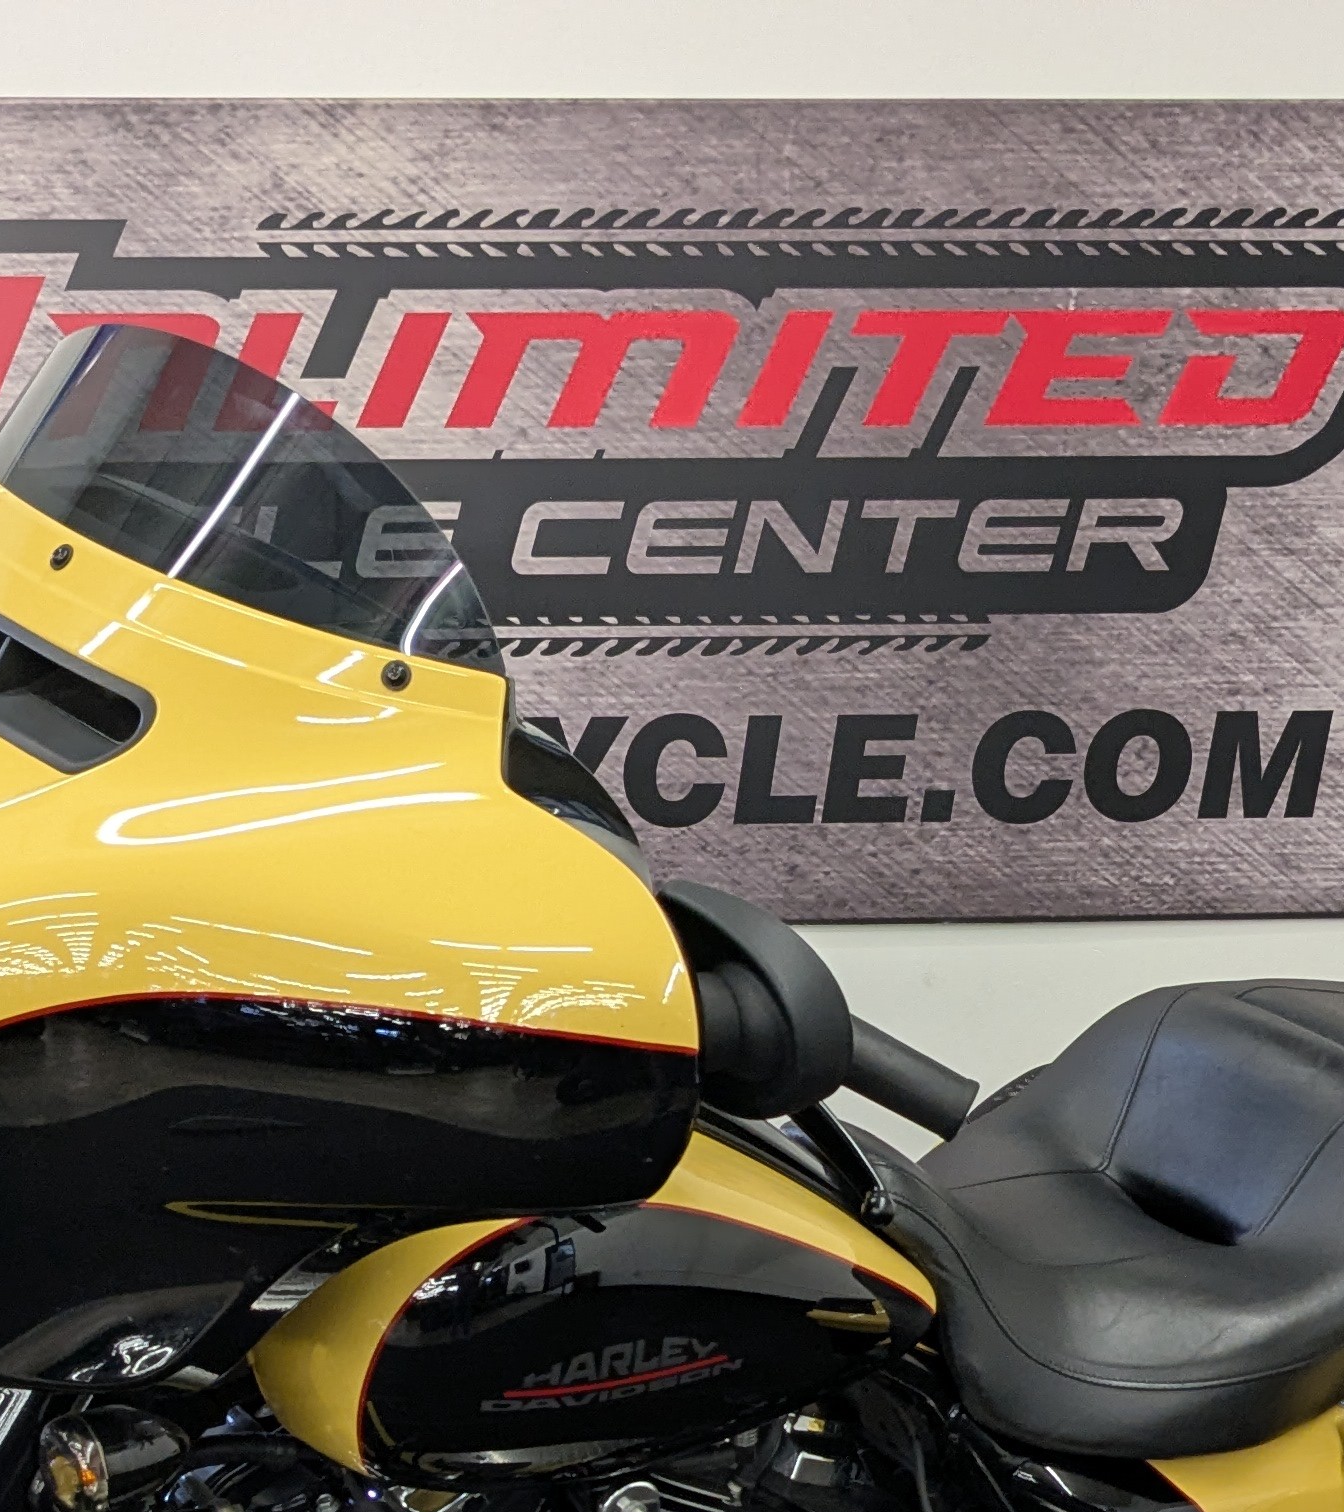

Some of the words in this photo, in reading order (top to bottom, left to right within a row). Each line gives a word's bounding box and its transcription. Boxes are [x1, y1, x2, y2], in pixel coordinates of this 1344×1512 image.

[511, 498, 1185, 576] CENTER
[523, 709, 1334, 829] YCLE.COM
[523, 1337, 719, 1389] HARLEY
